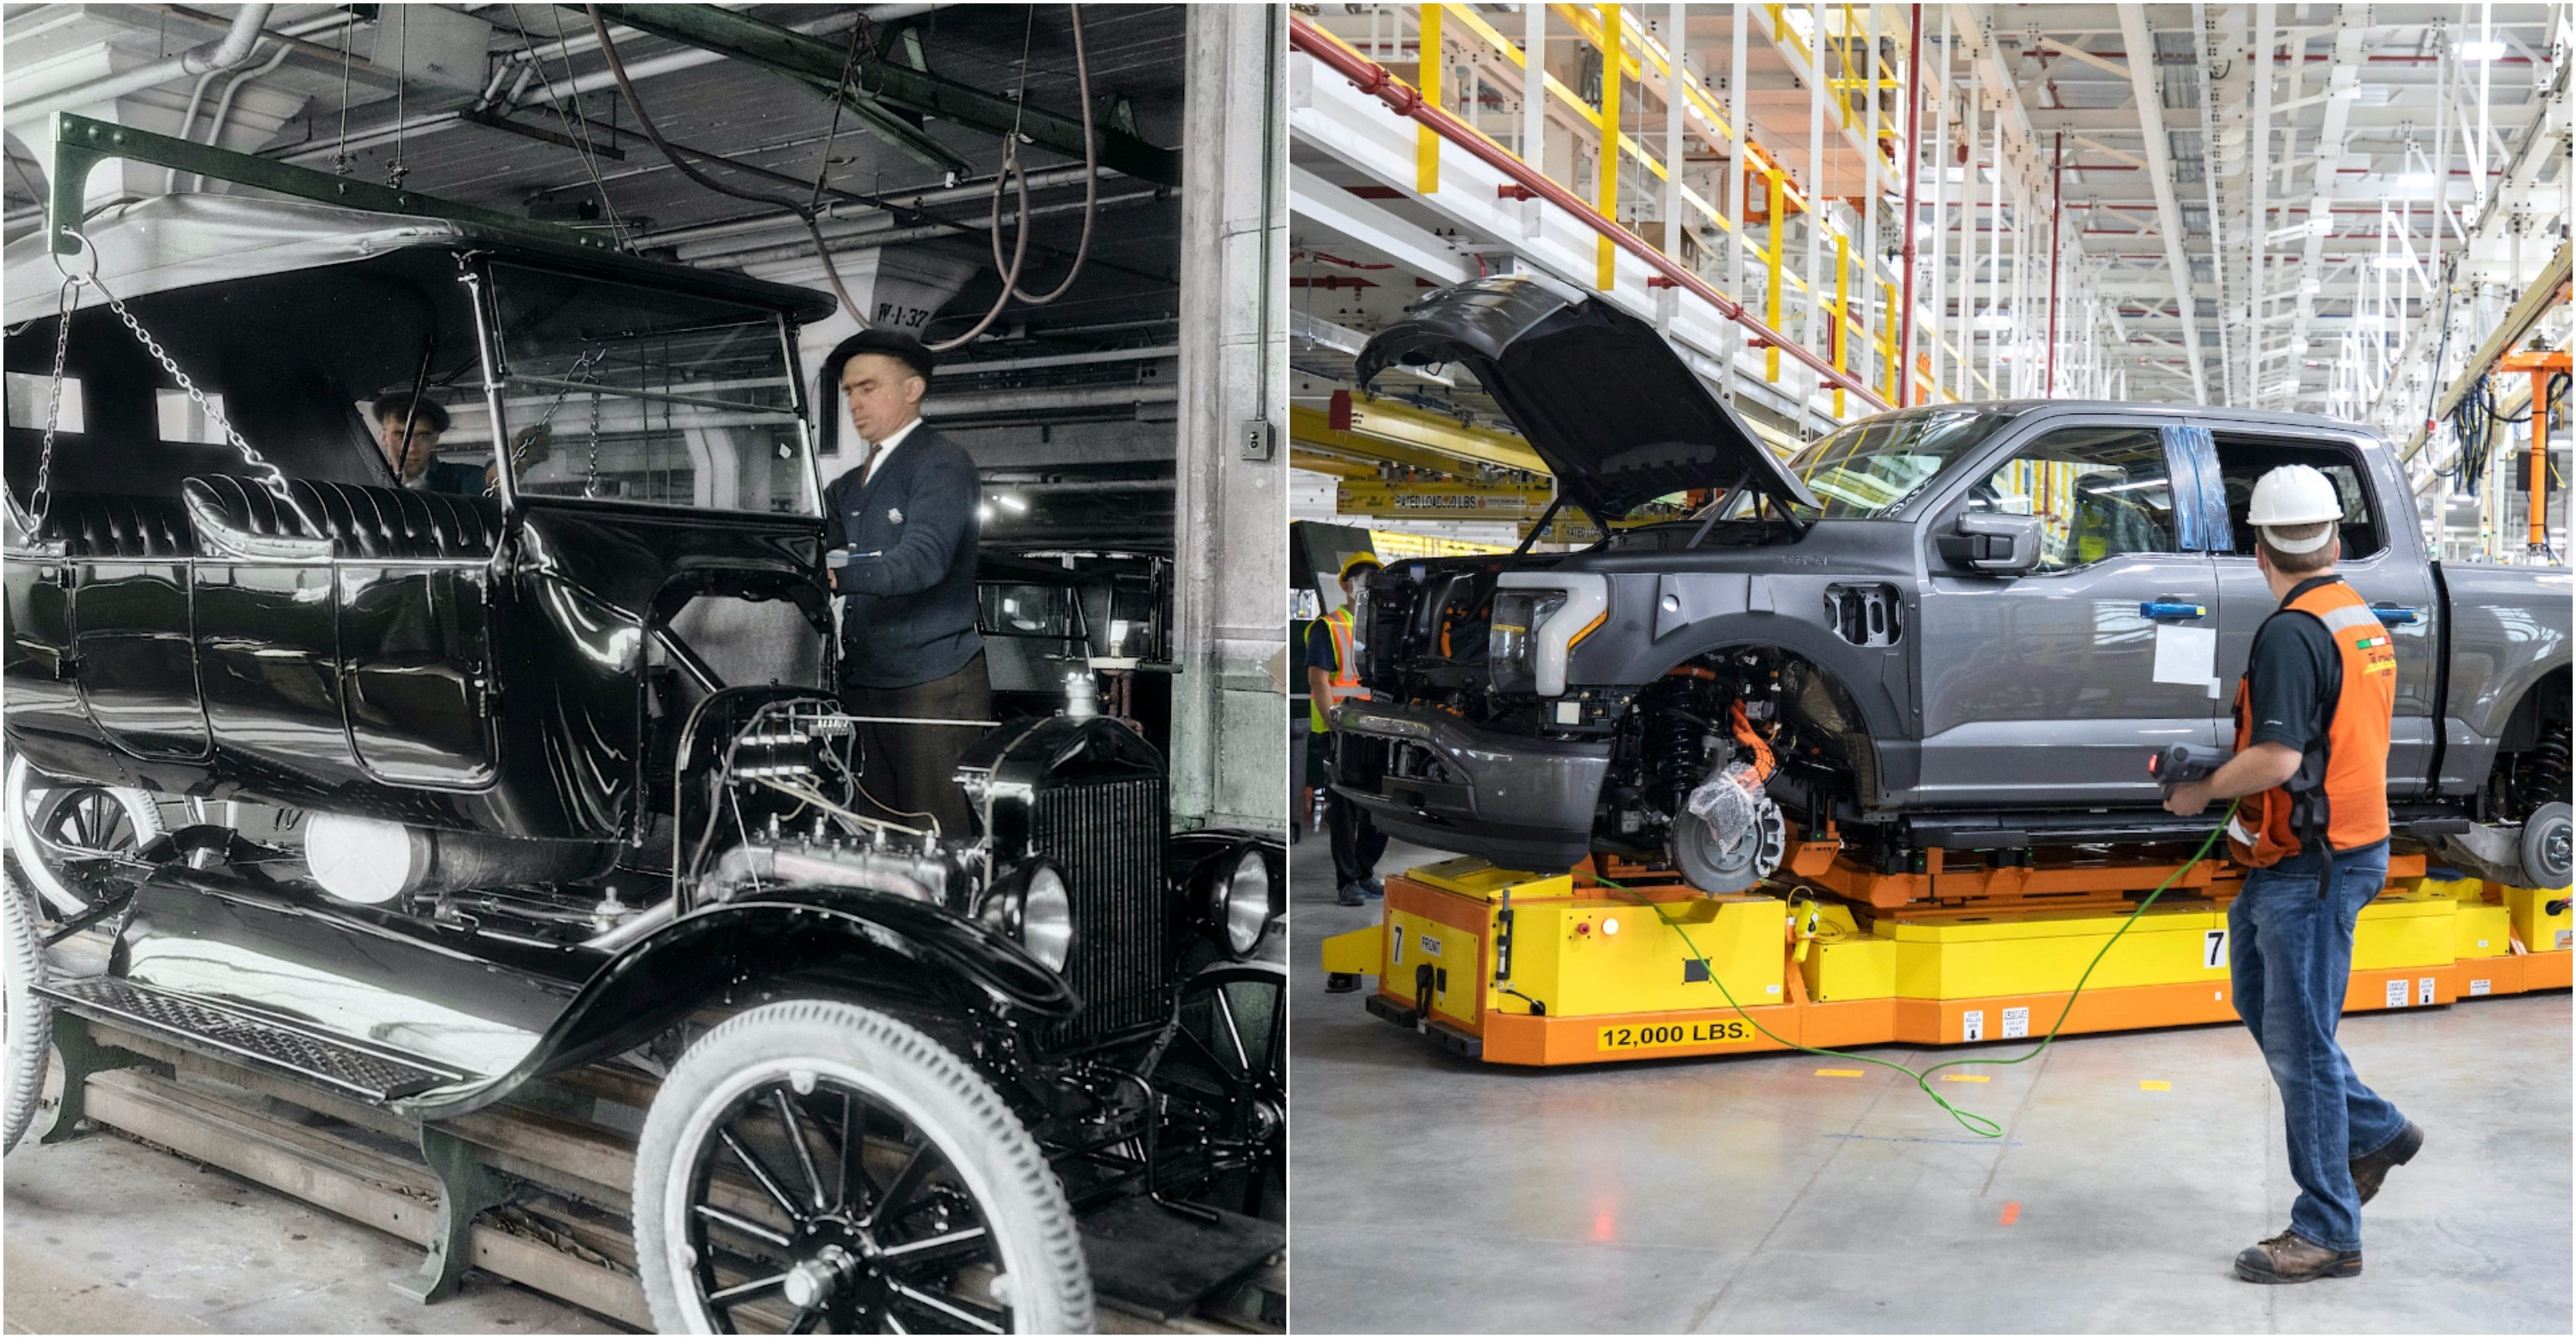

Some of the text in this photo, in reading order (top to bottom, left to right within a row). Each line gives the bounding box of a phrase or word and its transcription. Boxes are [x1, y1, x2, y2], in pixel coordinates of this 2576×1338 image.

[1395, 495, 1420, 508] RATED
[1459, 495, 1478, 508] LBS.
[1395, 925, 1403, 963] 7
[1422, 936, 1441, 954] FRONT
[2208, 932, 2224, 966] 7
[1603, 1022, 1750, 1048] 12,000 LBS.
